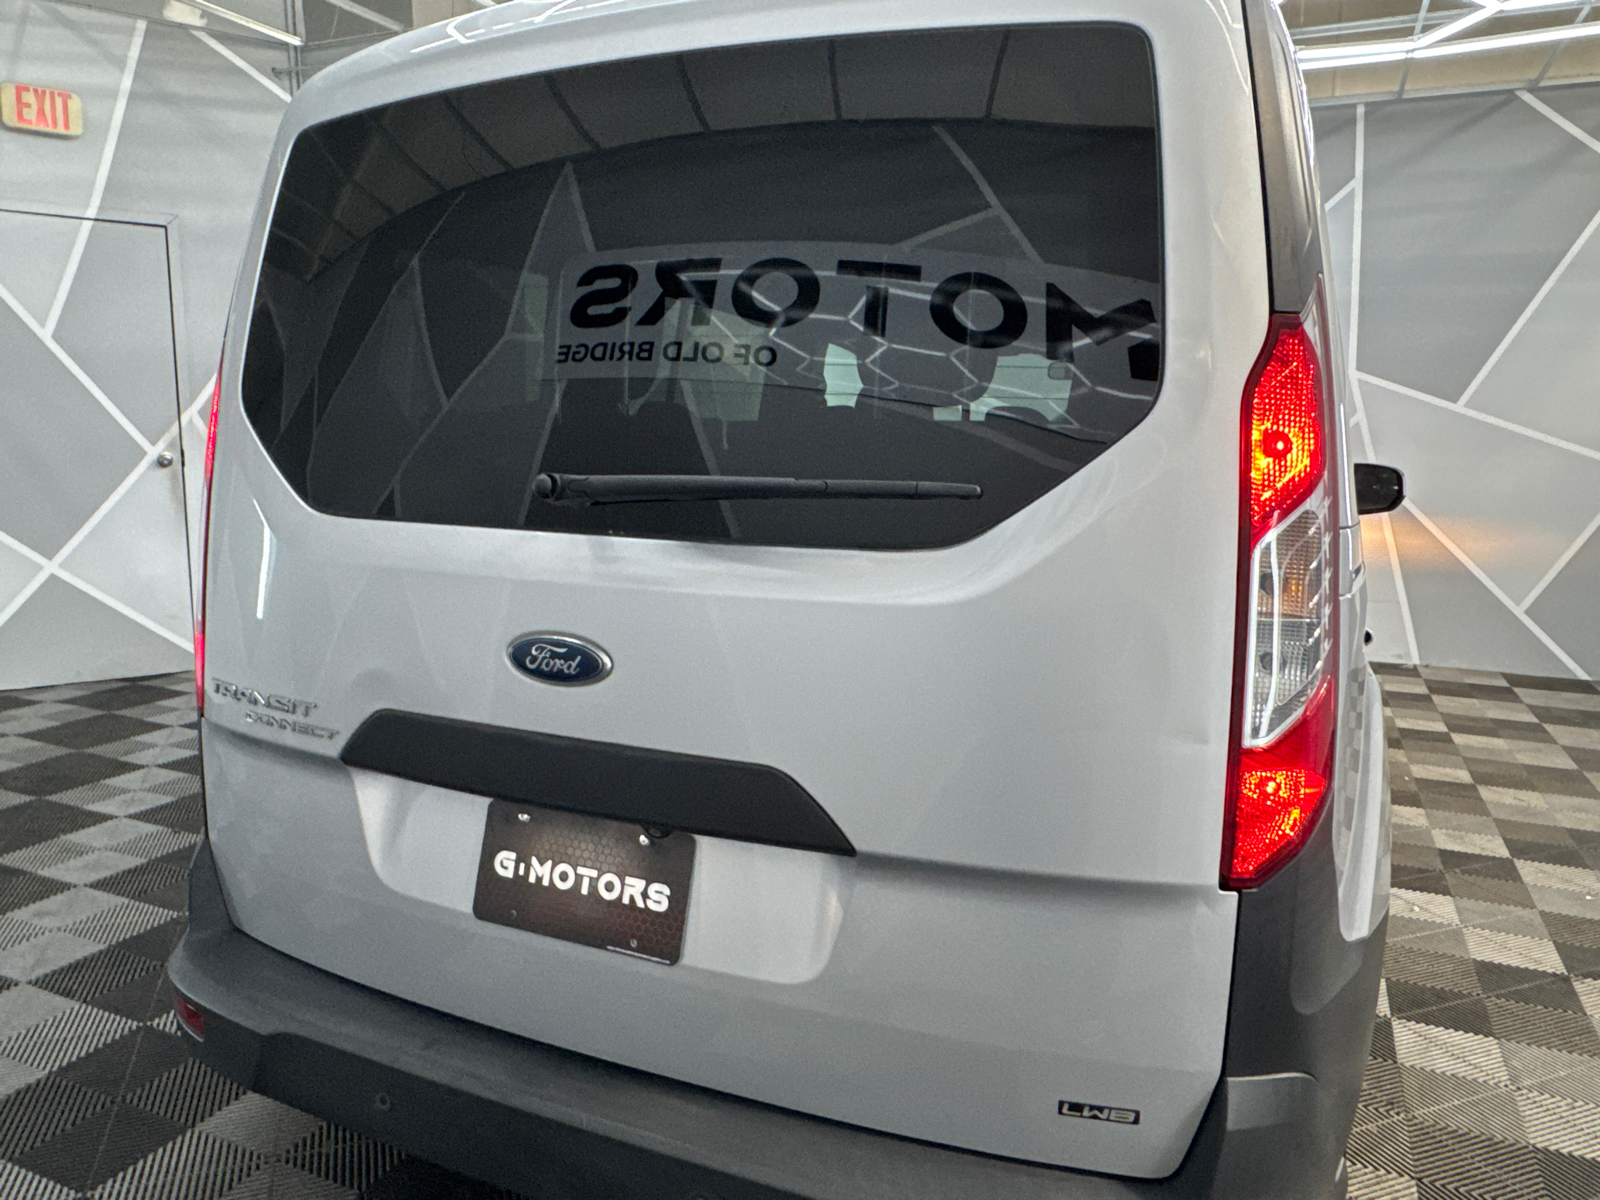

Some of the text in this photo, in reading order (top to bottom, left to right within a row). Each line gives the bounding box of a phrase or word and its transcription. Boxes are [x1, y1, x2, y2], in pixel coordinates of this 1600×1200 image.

[15, 84, 72, 131] EXIT
[525, 643, 582, 675] Ford
[212, 677, 317, 717] TRANSIT
[1061, 1102, 1136, 1123] LWB
